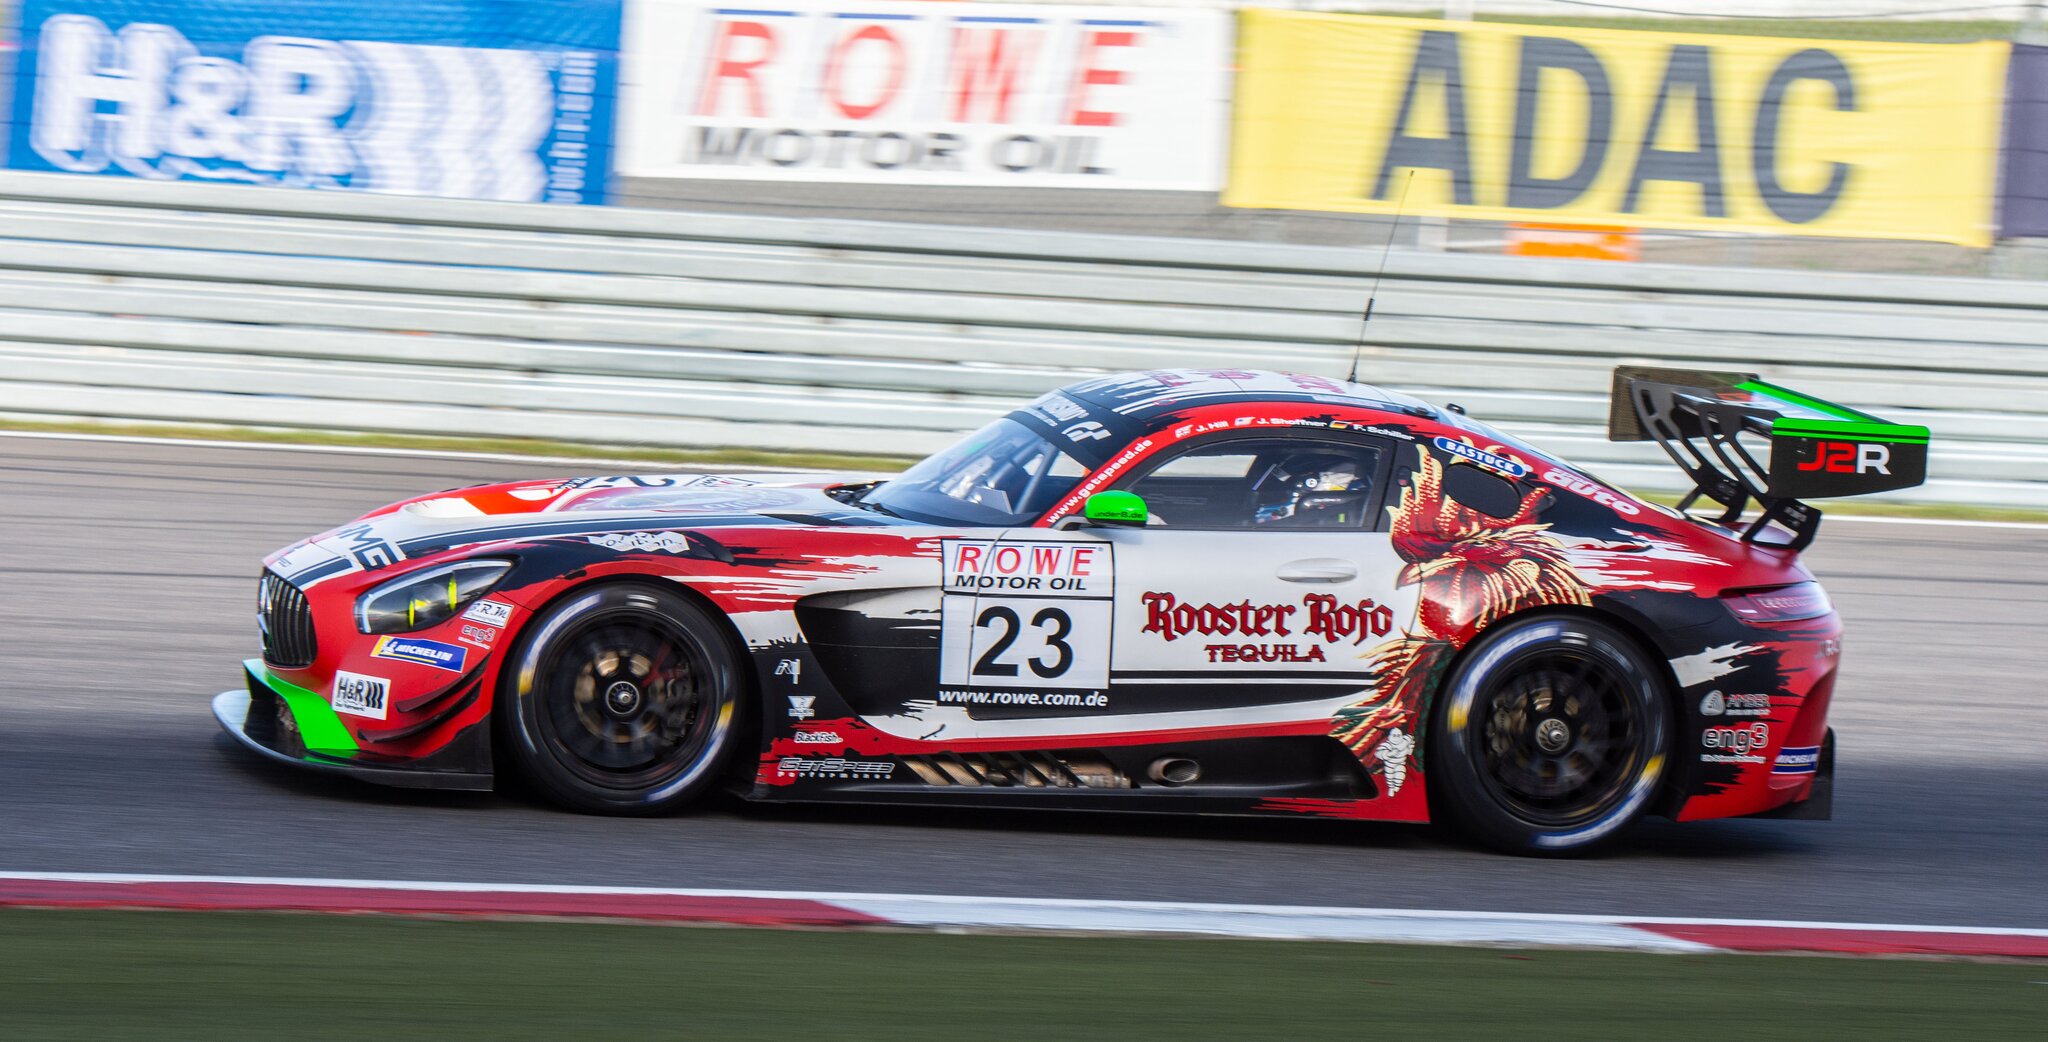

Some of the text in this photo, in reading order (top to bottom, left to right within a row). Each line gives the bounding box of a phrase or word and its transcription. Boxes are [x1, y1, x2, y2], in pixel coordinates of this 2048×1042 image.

[692, 20, 1142, 127] ROWE
[30, 14, 362, 180] H&R
[1368, 28, 1865, 225] ADAC
[682, 125, 1116, 176] MOTOR OIL
[1446, 441, 1516, 473] BASTUCK
[1797, 441, 1892, 475] J2R
[1543, 470, 1640, 516] auto
[957, 546, 1094, 576] ROWE
[955, 575, 1087, 590] MOTOR OIL
[461, 624, 496, 643] eng3
[1141, 591, 1394, 647] Rooster Rojo
[395, 644, 453, 661] MICHELIN
[972, 606, 1074, 678] 23
[1204, 644, 1327, 662] TEQUILA
[337, 676, 365, 703] H&R
[938, 690, 1109, 706] www.rowe.com.de
[1702, 722, 1769, 755] eng3
